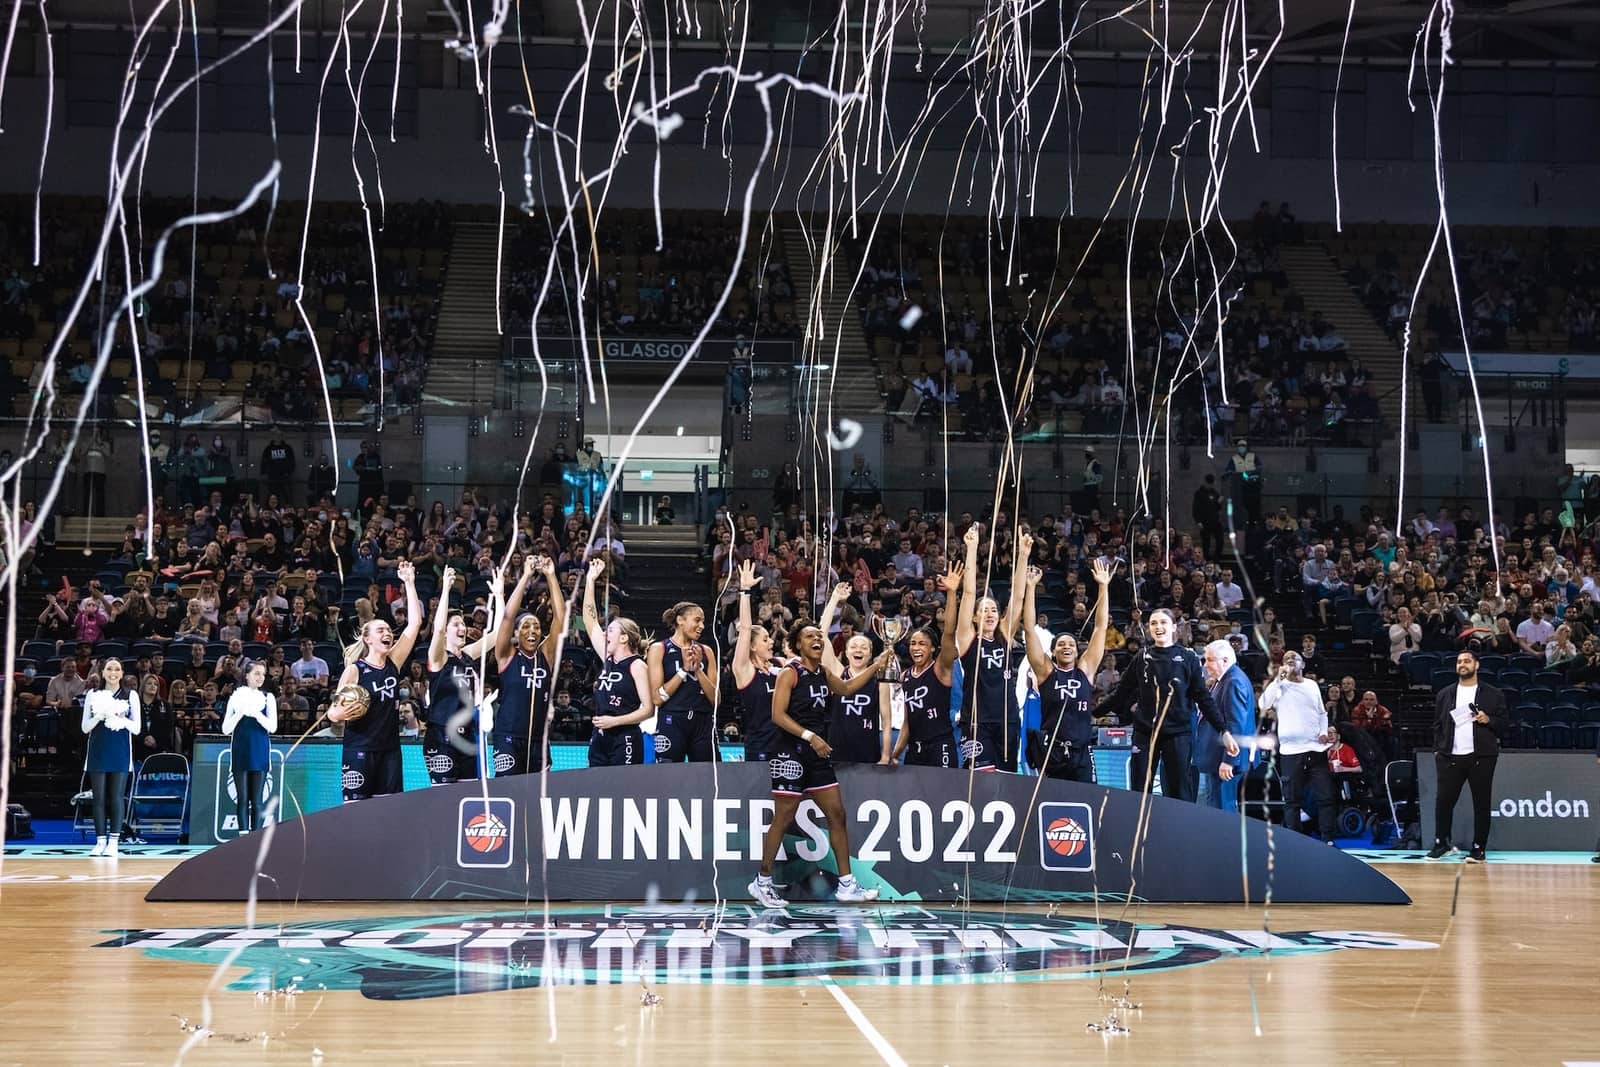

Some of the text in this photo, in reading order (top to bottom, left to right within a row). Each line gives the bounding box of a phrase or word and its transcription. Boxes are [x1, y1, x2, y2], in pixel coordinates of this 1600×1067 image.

[609, 695, 622, 707] 25
[1078, 701, 1088, 711] 13
[926, 708, 938, 719] 31
[863, 719, 873, 730] 14
[540, 798, 1017, 863] WINNERS 2022
[1045, 831, 1088, 841] WBBL
[121, 928, 1441, 950] TROPHY FINALS
